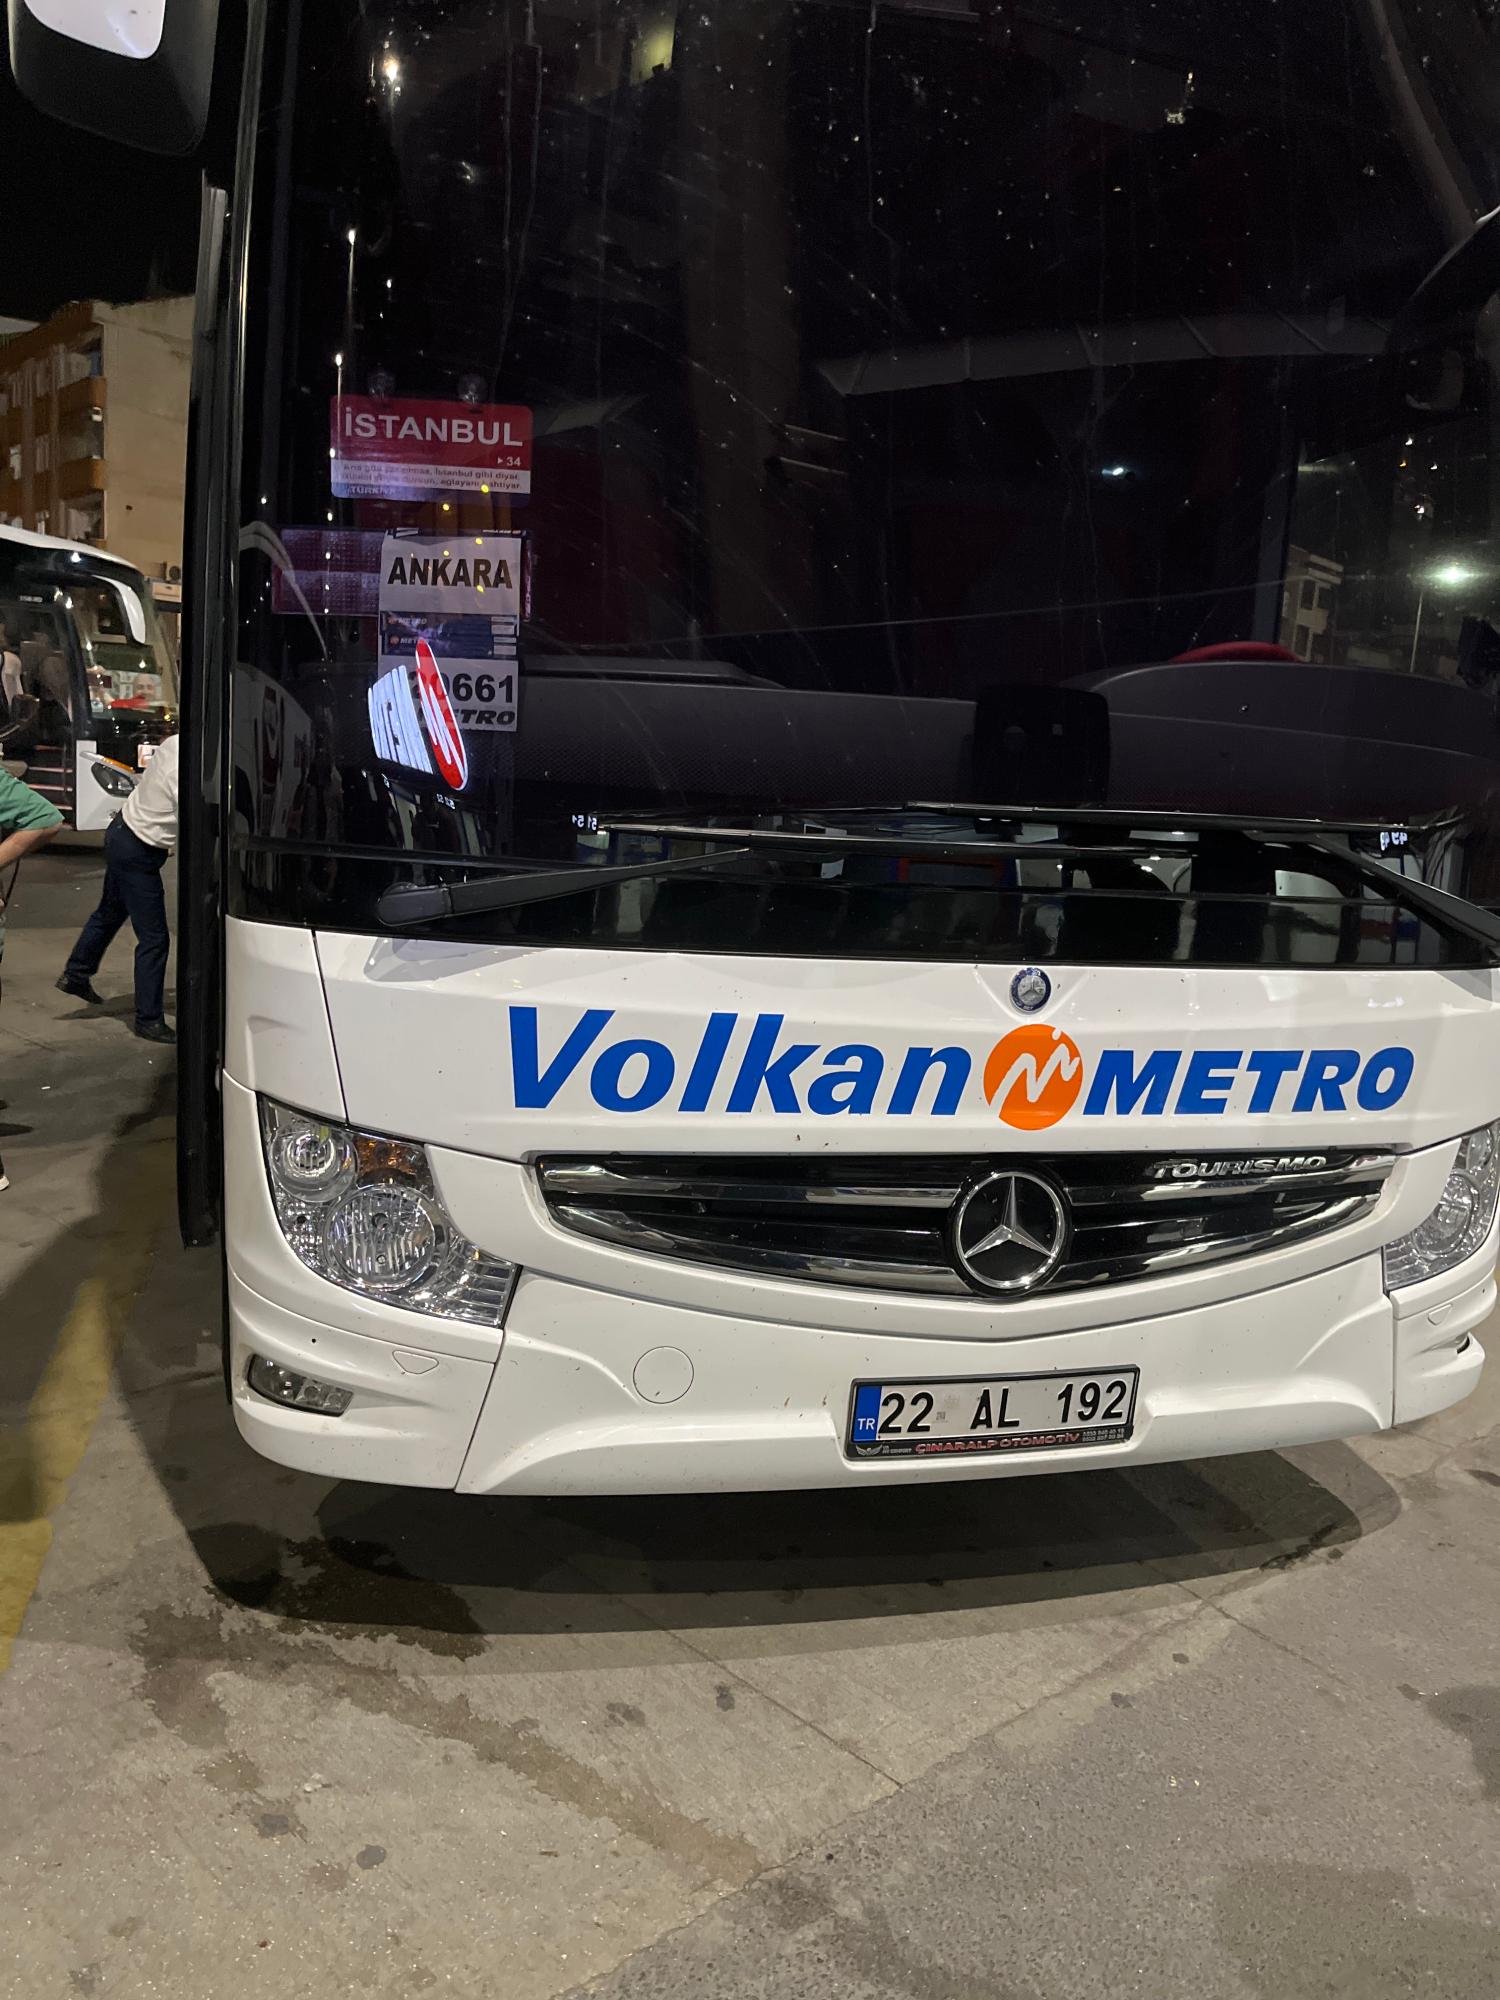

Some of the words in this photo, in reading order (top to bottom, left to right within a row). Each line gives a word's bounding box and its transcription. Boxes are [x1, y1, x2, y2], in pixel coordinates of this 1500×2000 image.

[345, 407, 523, 447] İSTANBUL
[506, 456, 521, 466] 34
[387, 557, 512, 589] ANKARA
[508, 1005, 972, 1116] Volkan
[1083, 1046, 1415, 1116] METRO
[1153, 1156, 1327, 1179] TOURISMO
[858, 1418, 876, 1431] TR
[878, 1391, 935, 1434] 22
[970, 1388, 1020, 1430] AL
[1057, 1379, 1127, 1424] 192
[1000, 1433, 1080, 1448] OTOMOTİV
